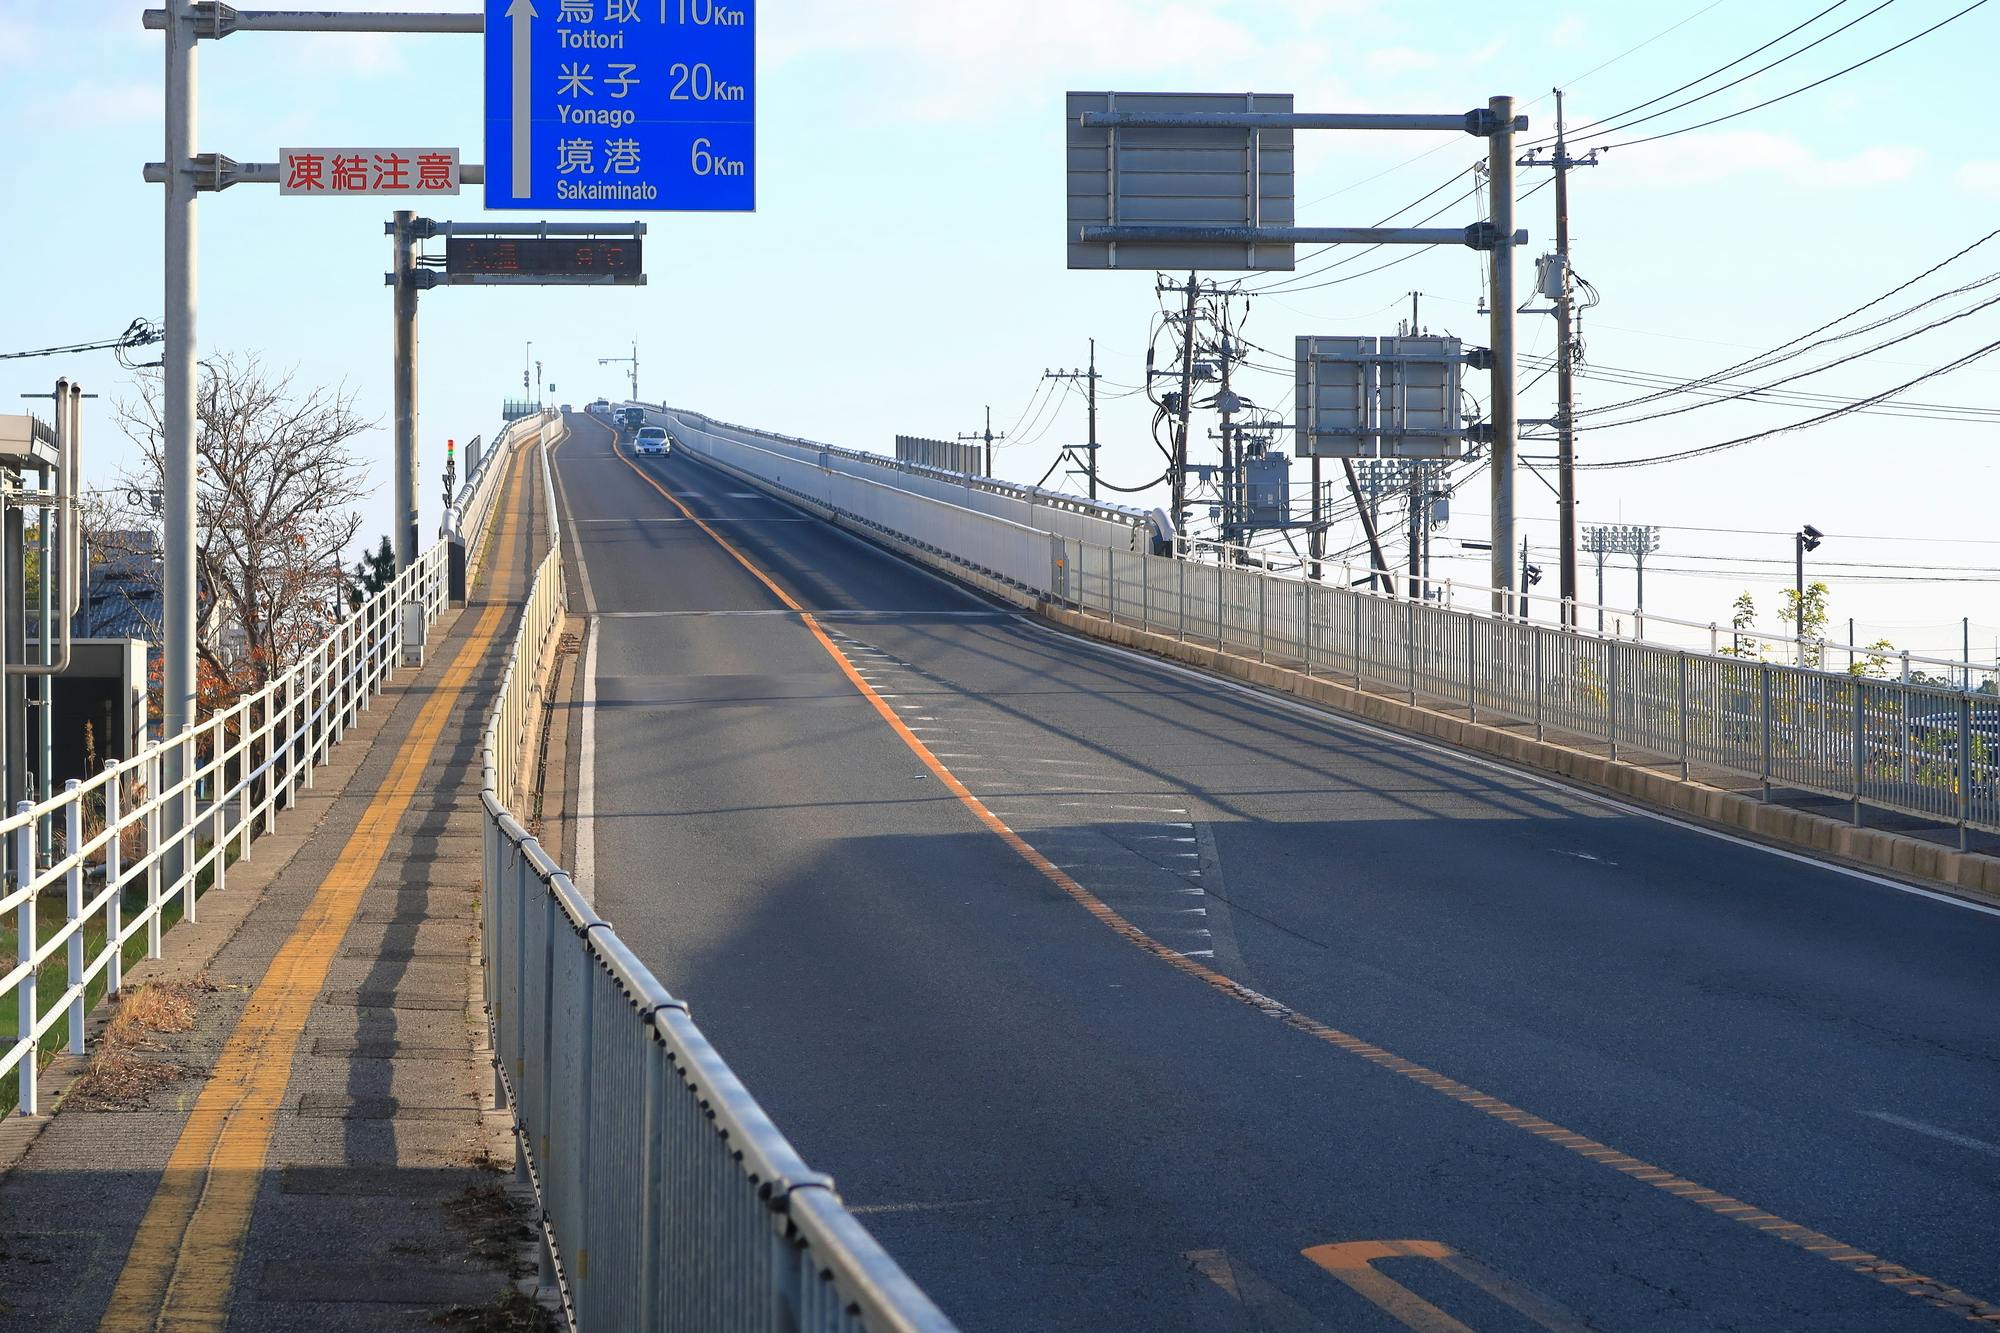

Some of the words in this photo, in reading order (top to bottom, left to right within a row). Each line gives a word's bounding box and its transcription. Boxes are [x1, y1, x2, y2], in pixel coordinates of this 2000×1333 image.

[557, 0, 641, 24] 鳥取
[557, 29, 624, 49] Tottori
[557, 62, 641, 99] 米子
[557, 104, 636, 129] Yonago
[556, 137, 641, 175] 境港
[287, 152, 453, 191] 凍結注意
[557, 179, 657, 201] Sakaiminato
